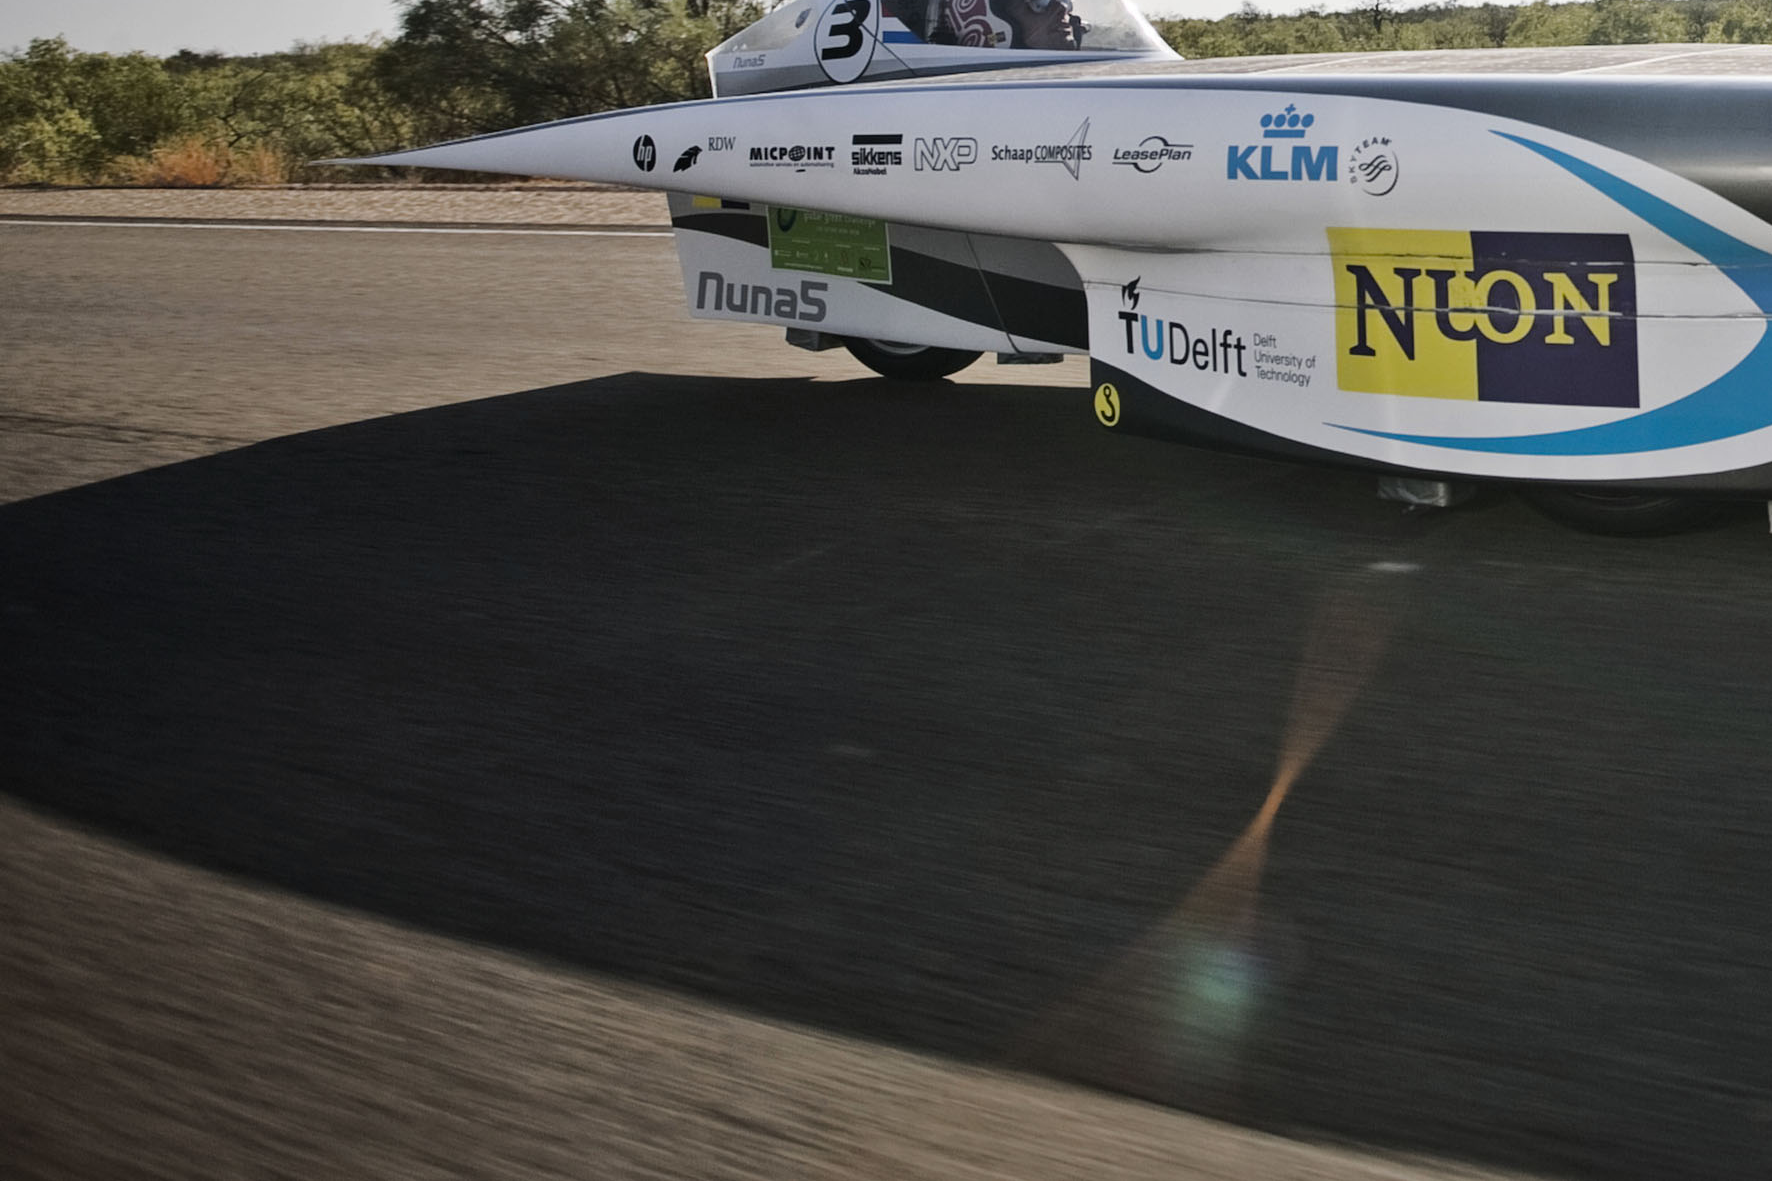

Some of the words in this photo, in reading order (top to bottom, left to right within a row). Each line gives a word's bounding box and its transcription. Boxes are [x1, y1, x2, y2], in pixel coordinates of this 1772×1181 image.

[635, 134, 654, 172] hp
[707, 136, 737, 152] RDW
[914, 137, 978, 171] NXP
[991, 144, 1033, 164] Schaap
[1034, 144, 1093, 161] COMPOSITES
[1113, 148, 1192, 161] LeasePlan
[851, 147, 903, 166] sikkens
[1227, 145, 1339, 181] KLM
[1348, 136, 1393, 185] SKYTEAM
[696, 270, 829, 323] Nuna5
[1345, 262, 1619, 361] NUON
[1253, 332, 1277, 348] Delft
[1254, 350, 1304, 370] University
[1304, 355, 1317, 369] of
[1255, 365, 1311, 387] Technology
